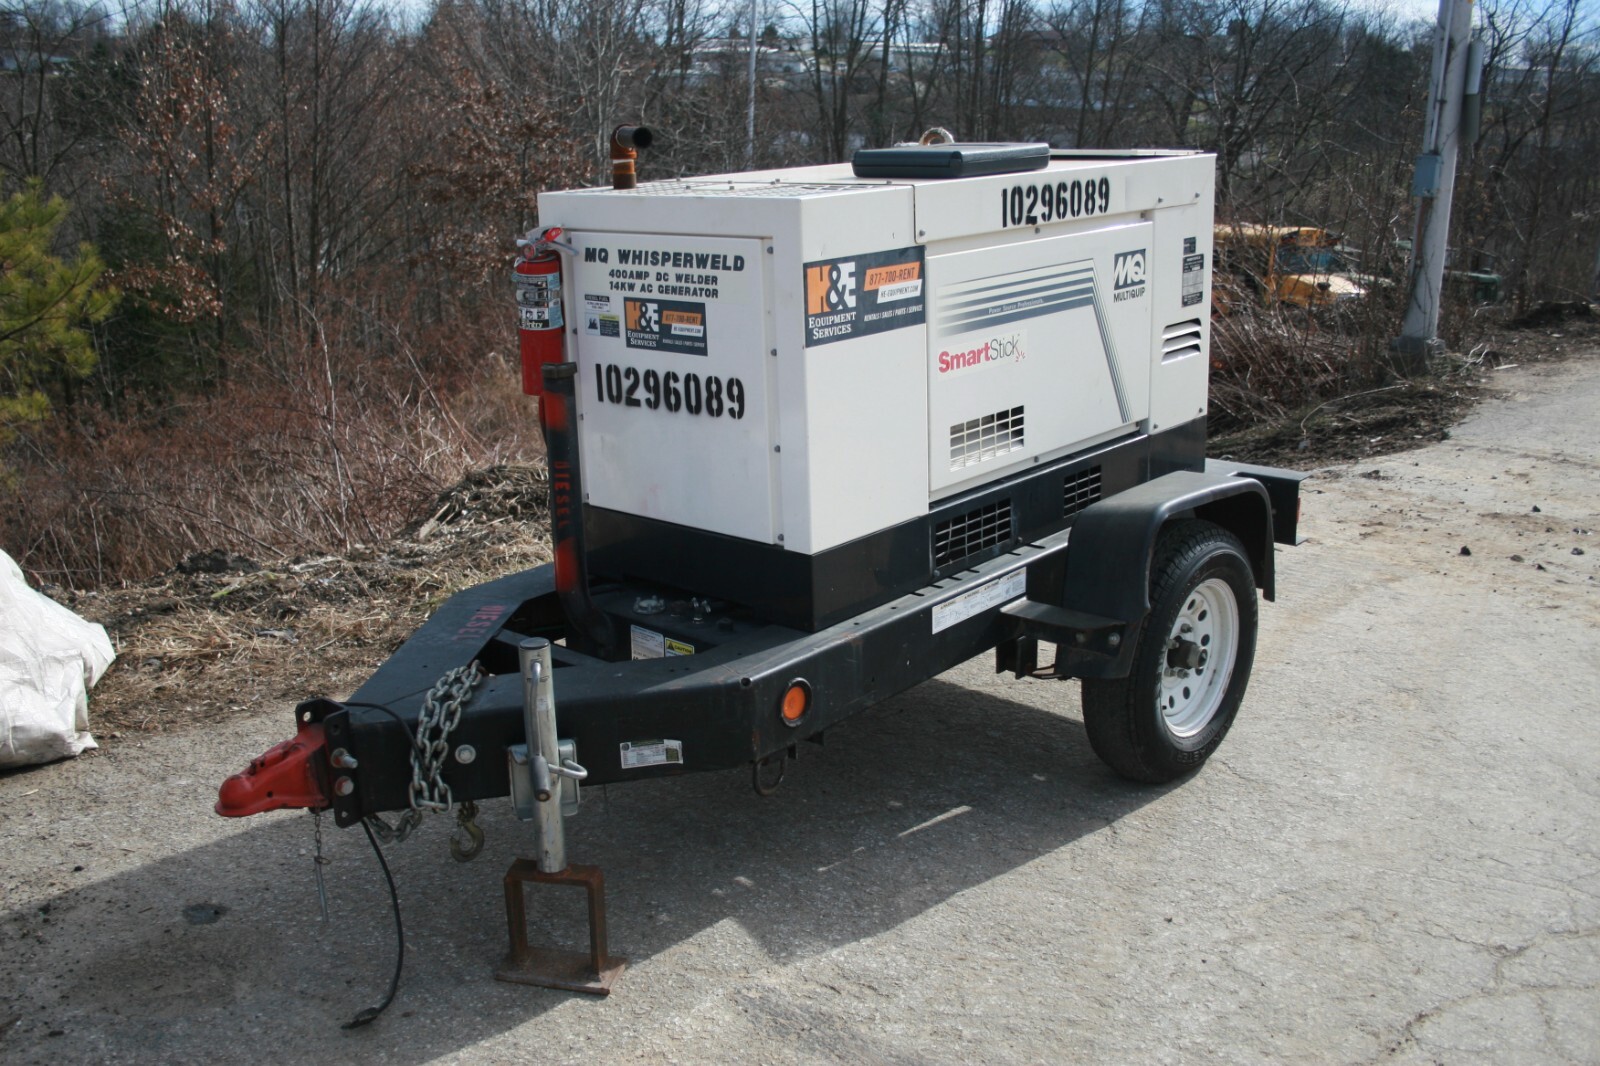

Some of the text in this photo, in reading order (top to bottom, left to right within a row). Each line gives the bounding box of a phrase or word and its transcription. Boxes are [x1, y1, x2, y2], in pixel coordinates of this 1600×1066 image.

[1002, 177, 1110, 228] 10296089
[584, 247, 745, 272] MQ WHISPERWELD
[1113, 253, 1146, 286] MQ
[608, 269, 718, 286] 400AMP DC WELDER
[869, 266, 915, 286] 877-700-RENT
[609, 281, 719, 298] 14KW AC GENERATOR
[806, 261, 857, 315] H&E
[1113, 286, 1146, 303] MULTIQUIP
[624, 301, 660, 333] H&E
[808, 311, 857, 329] EQUIPMENT
[627, 330, 660, 340] EQUIPMENT
[812, 323, 852, 340] SERVICES
[630, 338, 657, 347] SERVICES
[938, 335, 1021, 373] SmartStick
[595, 363, 745, 420] 10296089
